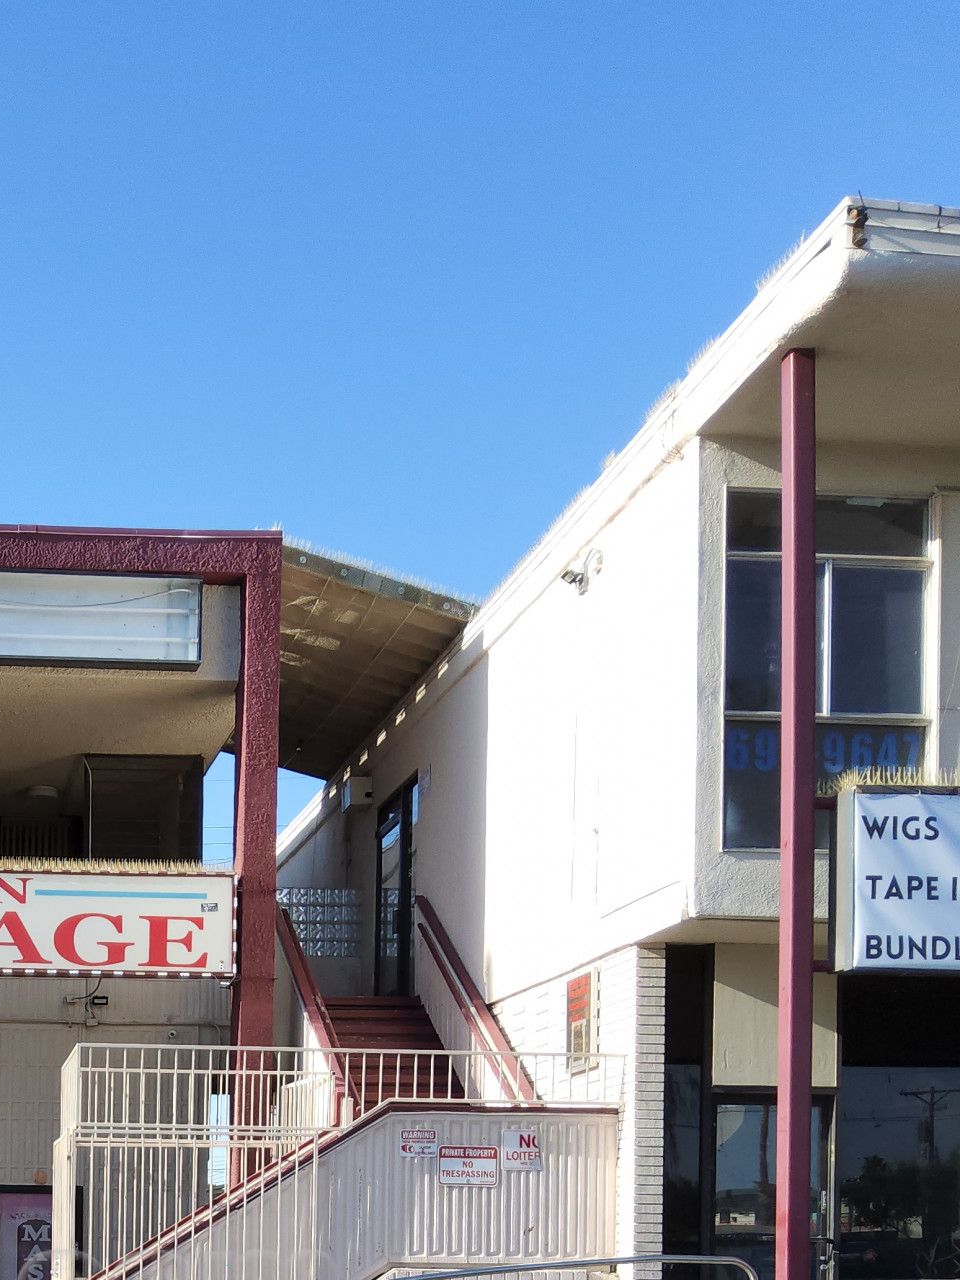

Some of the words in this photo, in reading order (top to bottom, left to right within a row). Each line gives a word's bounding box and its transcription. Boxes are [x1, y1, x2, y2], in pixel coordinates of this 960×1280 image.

[861, 815, 940, 841] WIGS
[865, 874, 940, 900] TAPE
[402, 1130, 435, 1139] WARNING
[441, 1148, 465, 1157] PRIVATE
[465, 1149, 496, 1158] PROPERTY
[462, 1160, 474, 1169] NO
[441, 1170, 495, 1178] TRESPASSING
